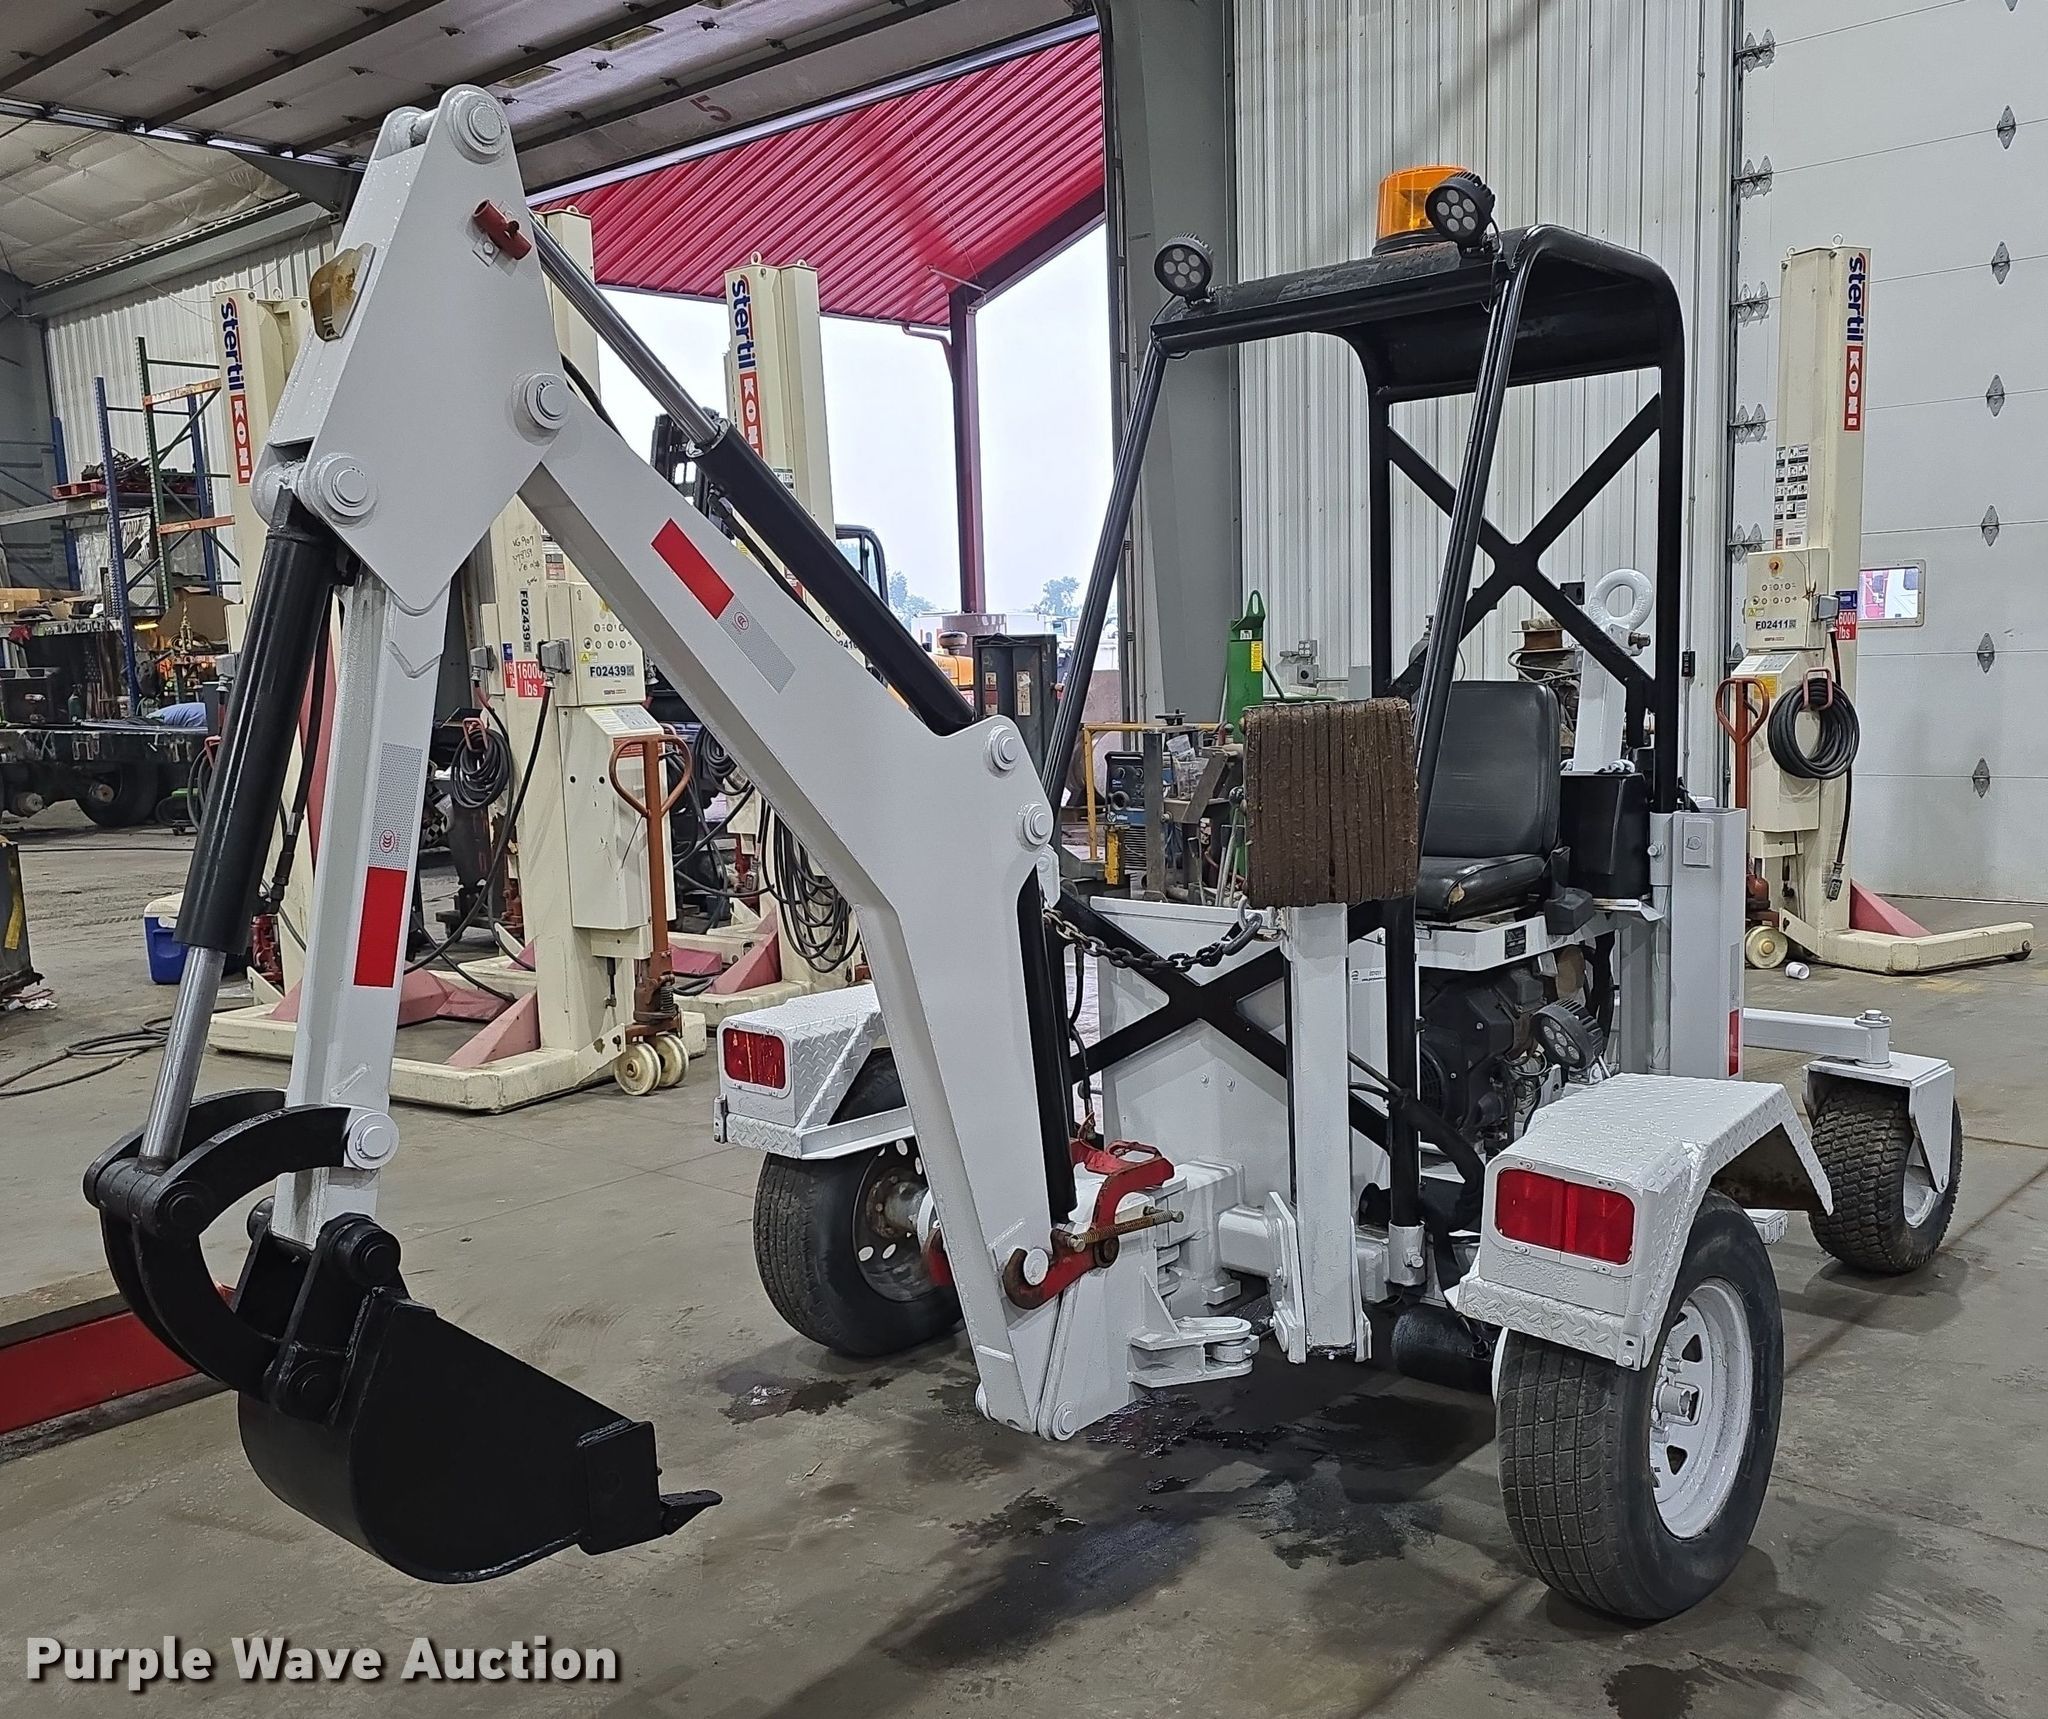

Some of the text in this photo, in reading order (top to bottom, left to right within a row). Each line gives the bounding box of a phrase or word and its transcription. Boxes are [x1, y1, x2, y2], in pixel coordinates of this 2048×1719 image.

[690, 95, 731, 122] 5
[1846, 349, 1860, 428] KONI
[233, 399, 251, 480] KONI
[520, 590, 532, 641] F02439
[1755, 619, 1789, 631] F02411
[1838, 625, 1851, 640] lbs
[590, 665, 627, 678] F02439
[523, 679, 539, 697] lbs
